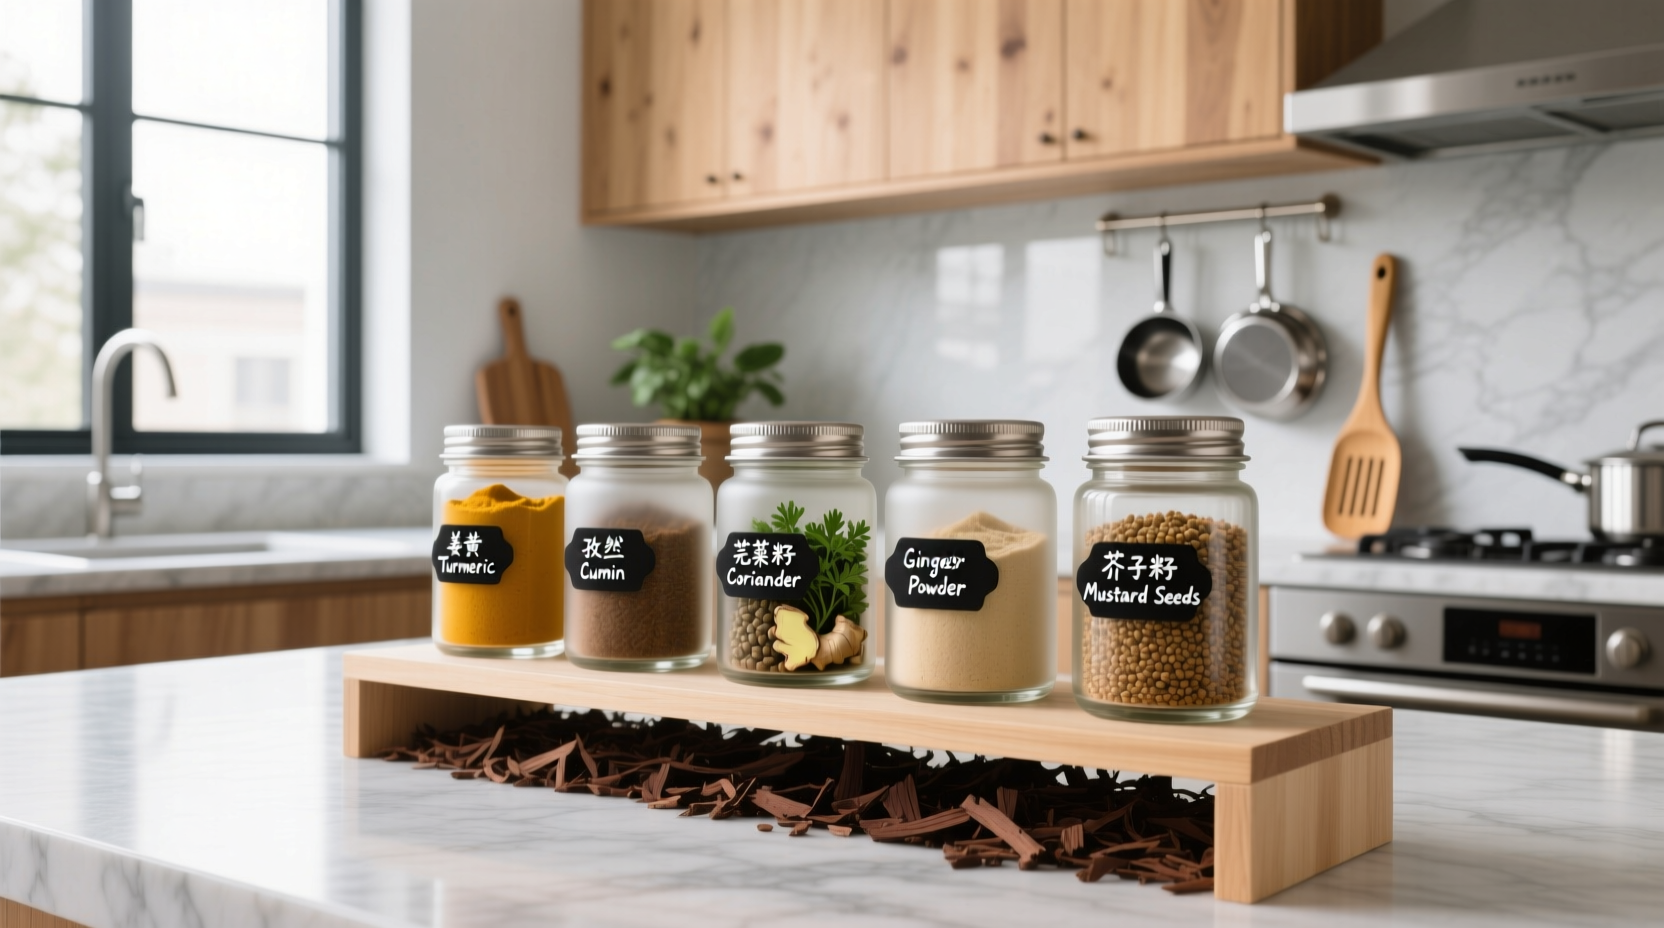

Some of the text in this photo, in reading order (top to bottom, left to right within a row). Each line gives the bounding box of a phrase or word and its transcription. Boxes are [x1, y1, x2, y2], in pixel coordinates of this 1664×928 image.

[446, 531, 483, 558] 姜黄
[438, 555, 496, 575] Turmeric
[580, 561, 625, 580] Cumin
[1103, 549, 1178, 582] 芥子籽
[727, 566, 802, 588] Coriander
[908, 575, 968, 597] Powder
[1083, 581, 1202, 606] Mustard Seeds
